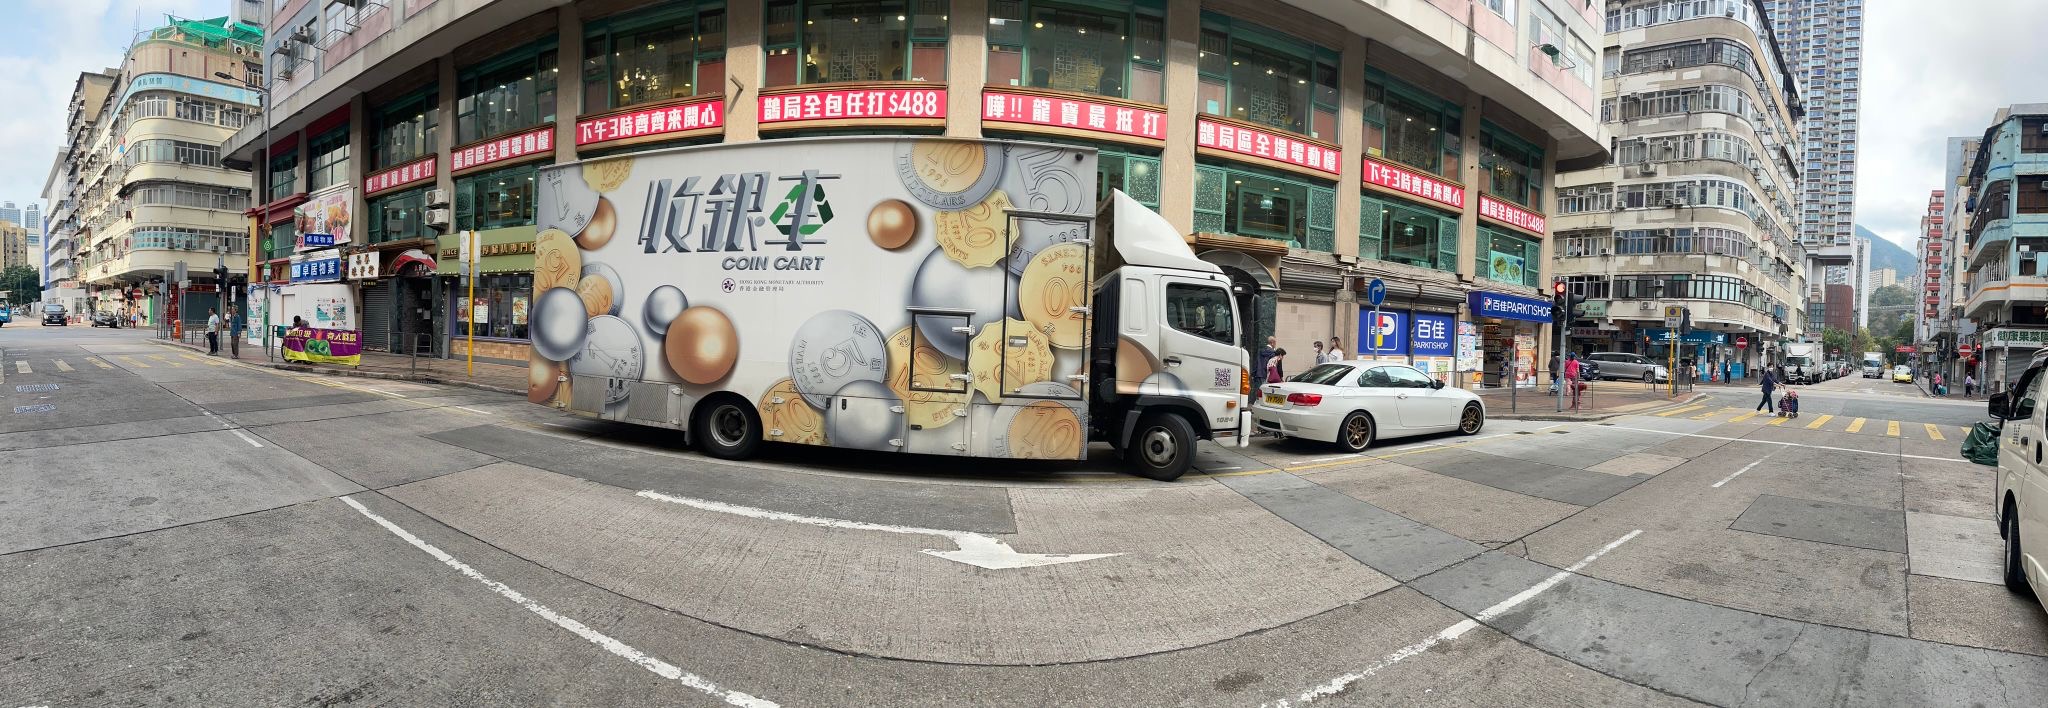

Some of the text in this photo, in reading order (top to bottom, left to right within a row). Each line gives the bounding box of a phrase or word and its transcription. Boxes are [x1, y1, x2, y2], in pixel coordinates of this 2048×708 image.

[580, 104, 716, 143] 下午3時齊齊來開心
[637, 169, 840, 254] 收銀車
[441, 248, 457, 256] SINCE
[302, 260, 336, 277] 卓居物業
[721, 256, 825, 271] COIN CART
[1493, 299, 1507, 312] 百佳
[1417, 319, 1446, 340] 百佳
